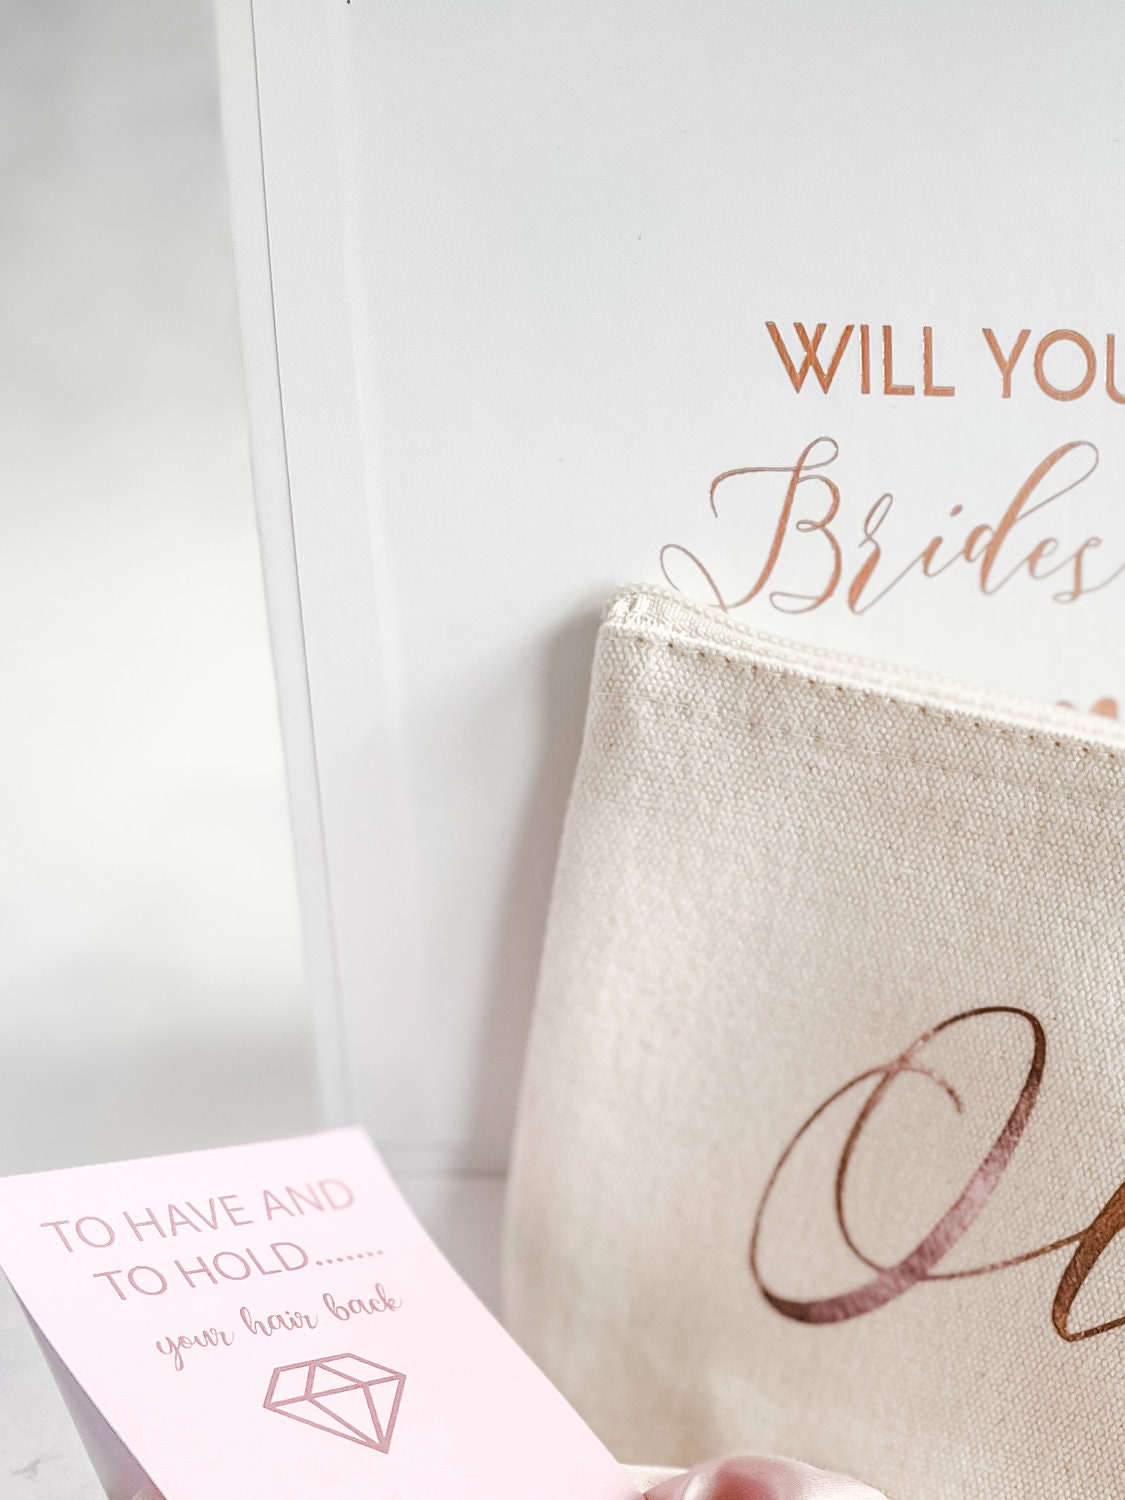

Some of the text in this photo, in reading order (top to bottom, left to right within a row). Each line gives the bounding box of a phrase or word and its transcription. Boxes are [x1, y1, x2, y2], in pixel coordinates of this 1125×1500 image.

[765, 321, 955, 396] WILL
[41, 1178, 355, 1253] TO HAVE AND
[93, 1266, 168, 1300] TO
[156, 1283, 402, 1371] your hair back
